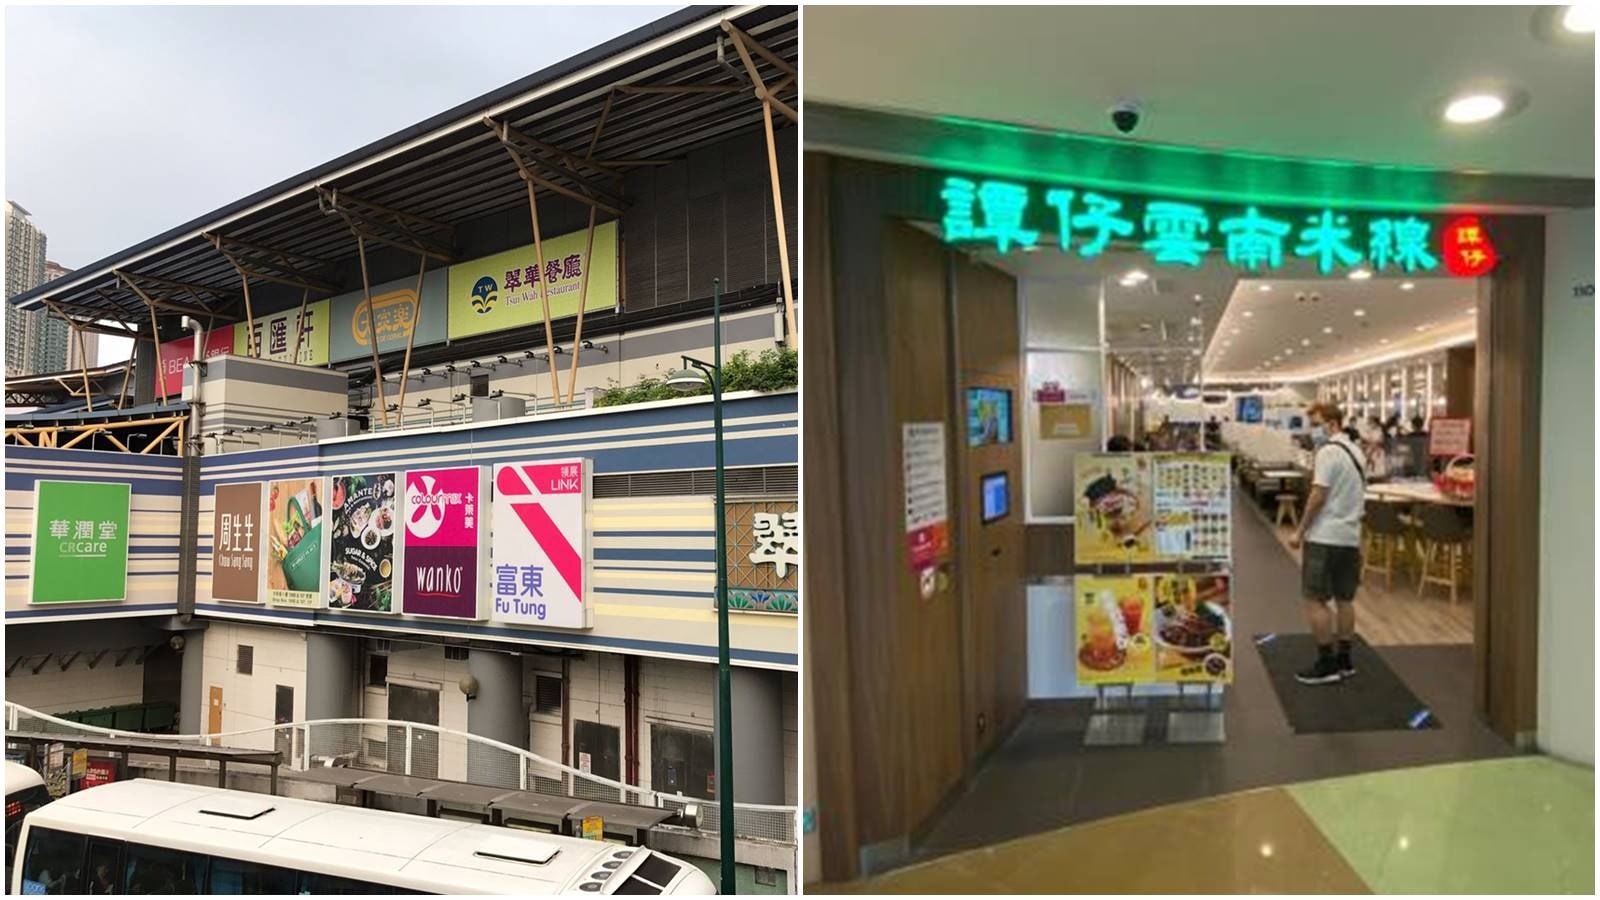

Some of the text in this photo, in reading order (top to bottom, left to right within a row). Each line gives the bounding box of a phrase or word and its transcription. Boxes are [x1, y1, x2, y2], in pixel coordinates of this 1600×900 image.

[940, 177, 1438, 275] 譚仔雲南米線
[504, 254, 582, 292] 翠華餐廳
[522, 290, 538, 302] Wah
[540, 281, 580, 299] estaurant
[561, 466, 578, 478] 領展
[551, 479, 579, 491] LINK
[49, 519, 118, 540] 華潤堂
[219, 513, 254, 551] 周生生
[345, 547, 361, 557] SUGAR
[416, 564, 462, 594] wanko
[496, 563, 544, 597] 富東
[496, 598, 547, 620] Fu Tung
